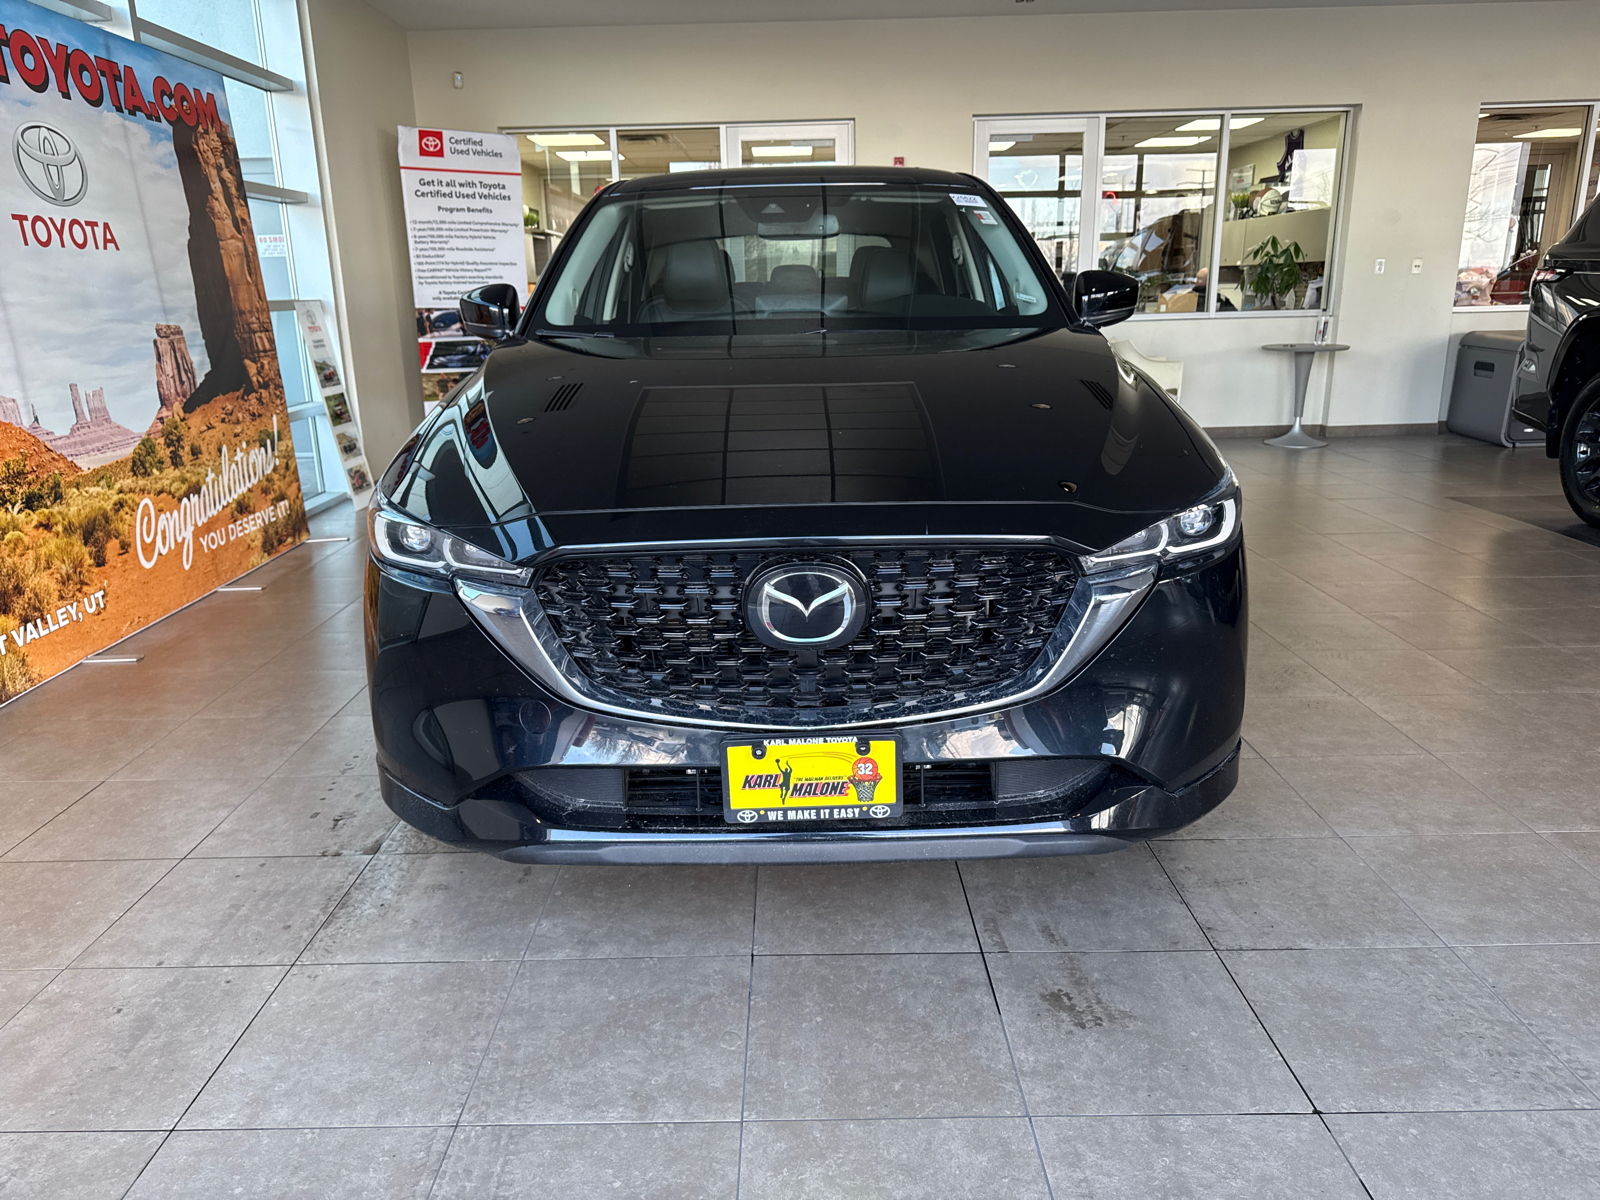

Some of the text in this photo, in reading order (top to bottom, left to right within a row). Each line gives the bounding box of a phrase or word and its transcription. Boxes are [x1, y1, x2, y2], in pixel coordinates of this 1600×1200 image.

[449, 136, 483, 146] Certified
[450, 146, 503, 158] Used Vehicles
[418, 178, 506, 191] Get it all with Toyota
[414, 189, 511, 201] Certified Used Vehicles
[438, 206, 465, 214] Program
[11, 213, 120, 251] TOYOTA
[136, 415, 280, 571] Congratulations!
[199, 499, 290, 553] YOU DESERVE IT!
[10, 602, 84, 648] VALLEY,
[83, 590, 105, 614] UT
[764, 738, 787, 746] KARL
[788, 737, 824, 745] MALONE
[857, 762, 873, 775] 32
[741, 773, 782, 790] KARL
[789, 781, 850, 799] MALONE
[768, 807, 860, 821] WE MAKE IT EASY
